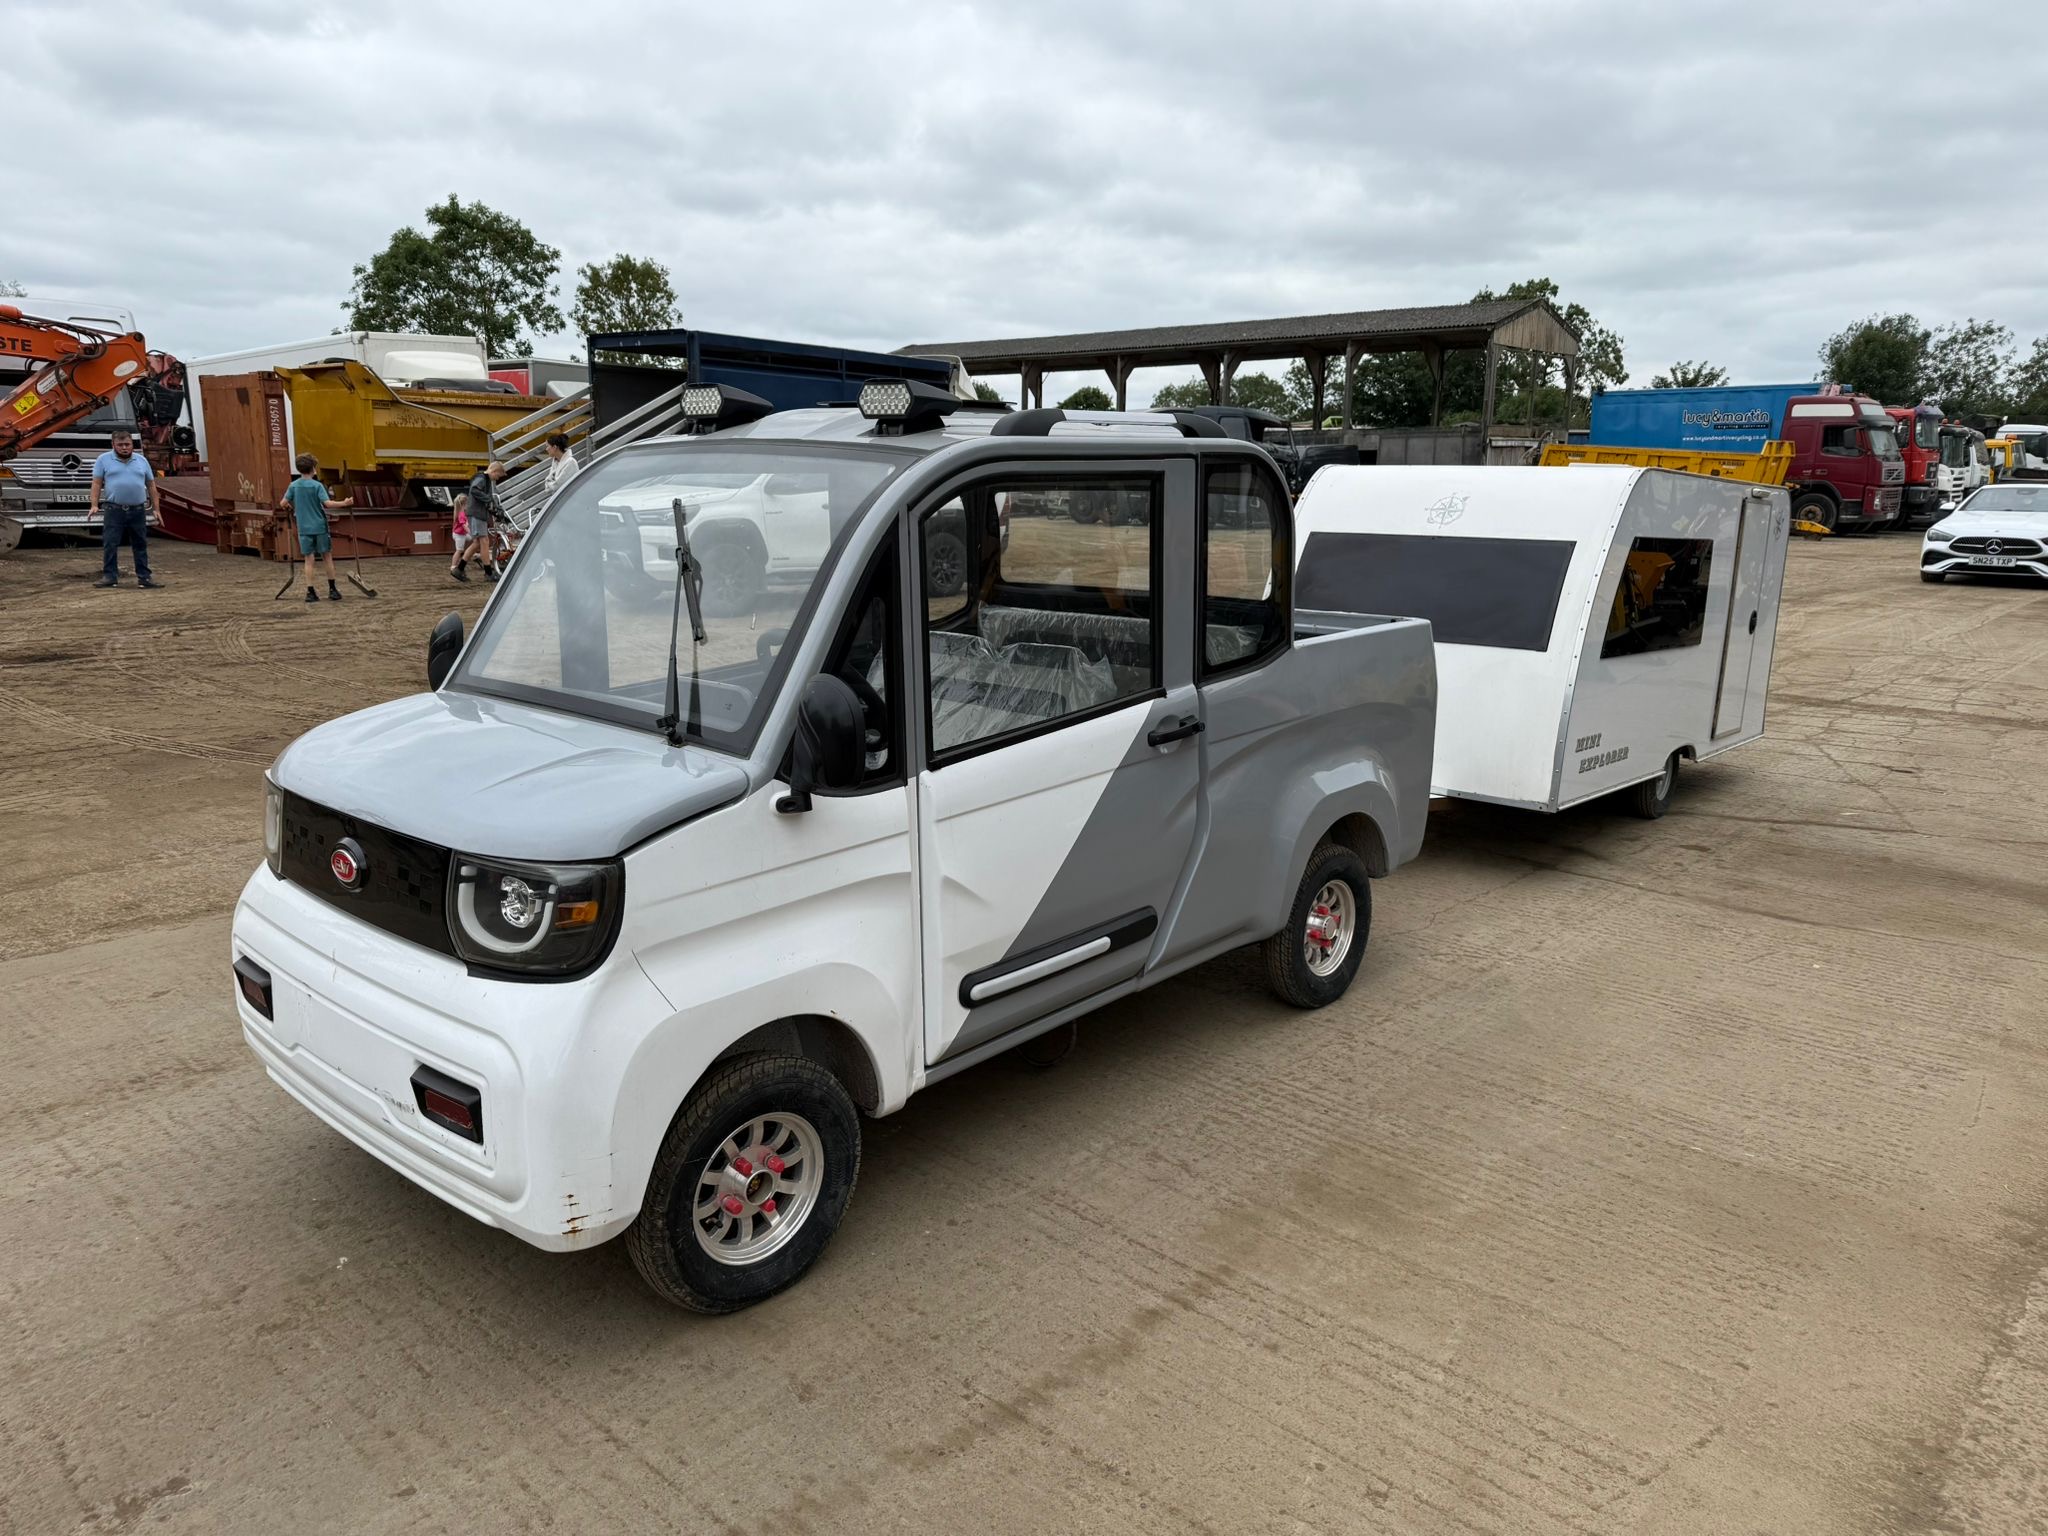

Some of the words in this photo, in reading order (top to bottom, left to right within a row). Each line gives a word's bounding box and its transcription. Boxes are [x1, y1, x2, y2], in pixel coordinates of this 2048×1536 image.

[1682, 409, 1770, 428] lucy&martin
[1972, 556, 1994, 565] SN25
[1996, 557, 2013, 566] TXP
[1575, 733, 1602, 753] MINI
[1579, 746, 1629, 774] EXPLORER
